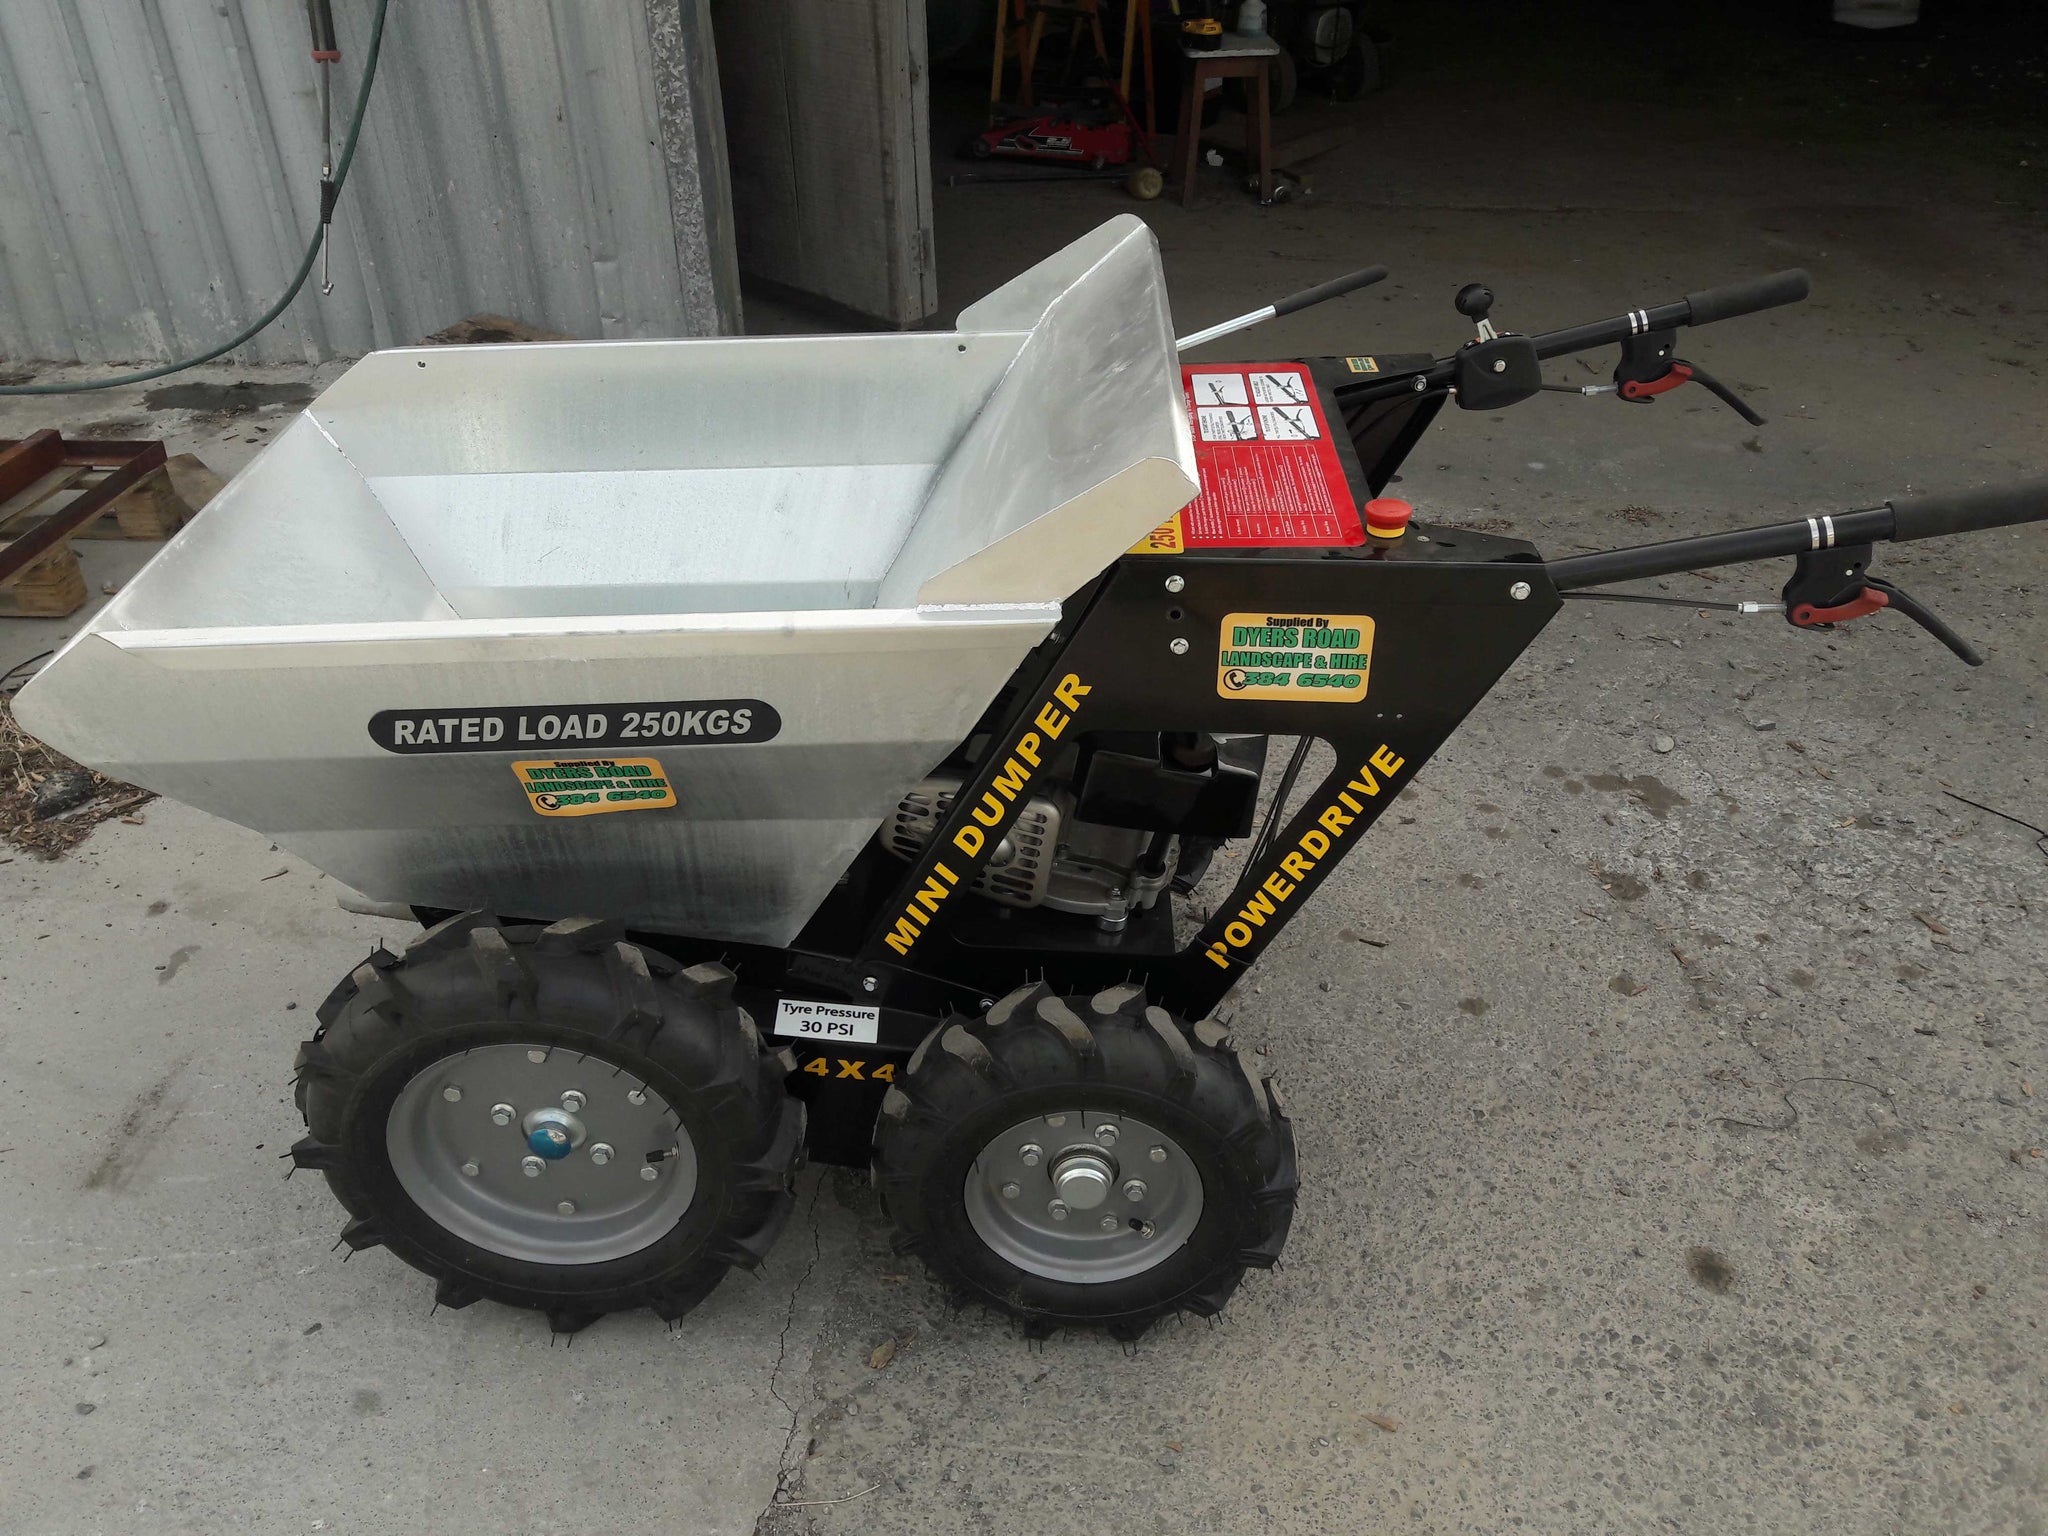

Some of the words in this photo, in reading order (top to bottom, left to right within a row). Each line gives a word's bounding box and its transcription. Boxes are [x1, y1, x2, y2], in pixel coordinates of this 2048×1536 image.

[1266, 616, 1313, 628] Supplied
[1315, 617, 1329, 629] By
[1232, 626, 1299, 649] DYERS
[1302, 627, 1361, 650] ROAD
[1221, 650, 1313, 669] LANDSCAPE
[1314, 655, 1327, 670] &
[1329, 653, 1368, 671] HIRE
[1242, 671, 1291, 687] 384
[1296, 672, 1361, 689] 6540
[394, 716, 504, 745] RATED
[517, 713, 608, 741] LOAD
[619, 708, 753, 738] 250KGS
[526, 766, 593, 780] DYERS
[594, 764, 652, 778] ROAD
[524, 779, 616, 794] LANDSCAPE
[629, 778, 668, 789] HIRE
[555, 792, 600, 806] 384
[606, 789, 667, 802] 6540
[884, 861, 960, 956] MINI
[952, 673, 1093, 859] DUMPER
[1204, 743, 1406, 970] POWERDRIVE
[782, 1002, 812, 1015] Tyre
[816, 1005, 876, 1020] Pressure
[799, 1020, 822, 1034] 30
[827, 1022, 854, 1036] PSI
[803, 1057, 896, 1083] 4X4
